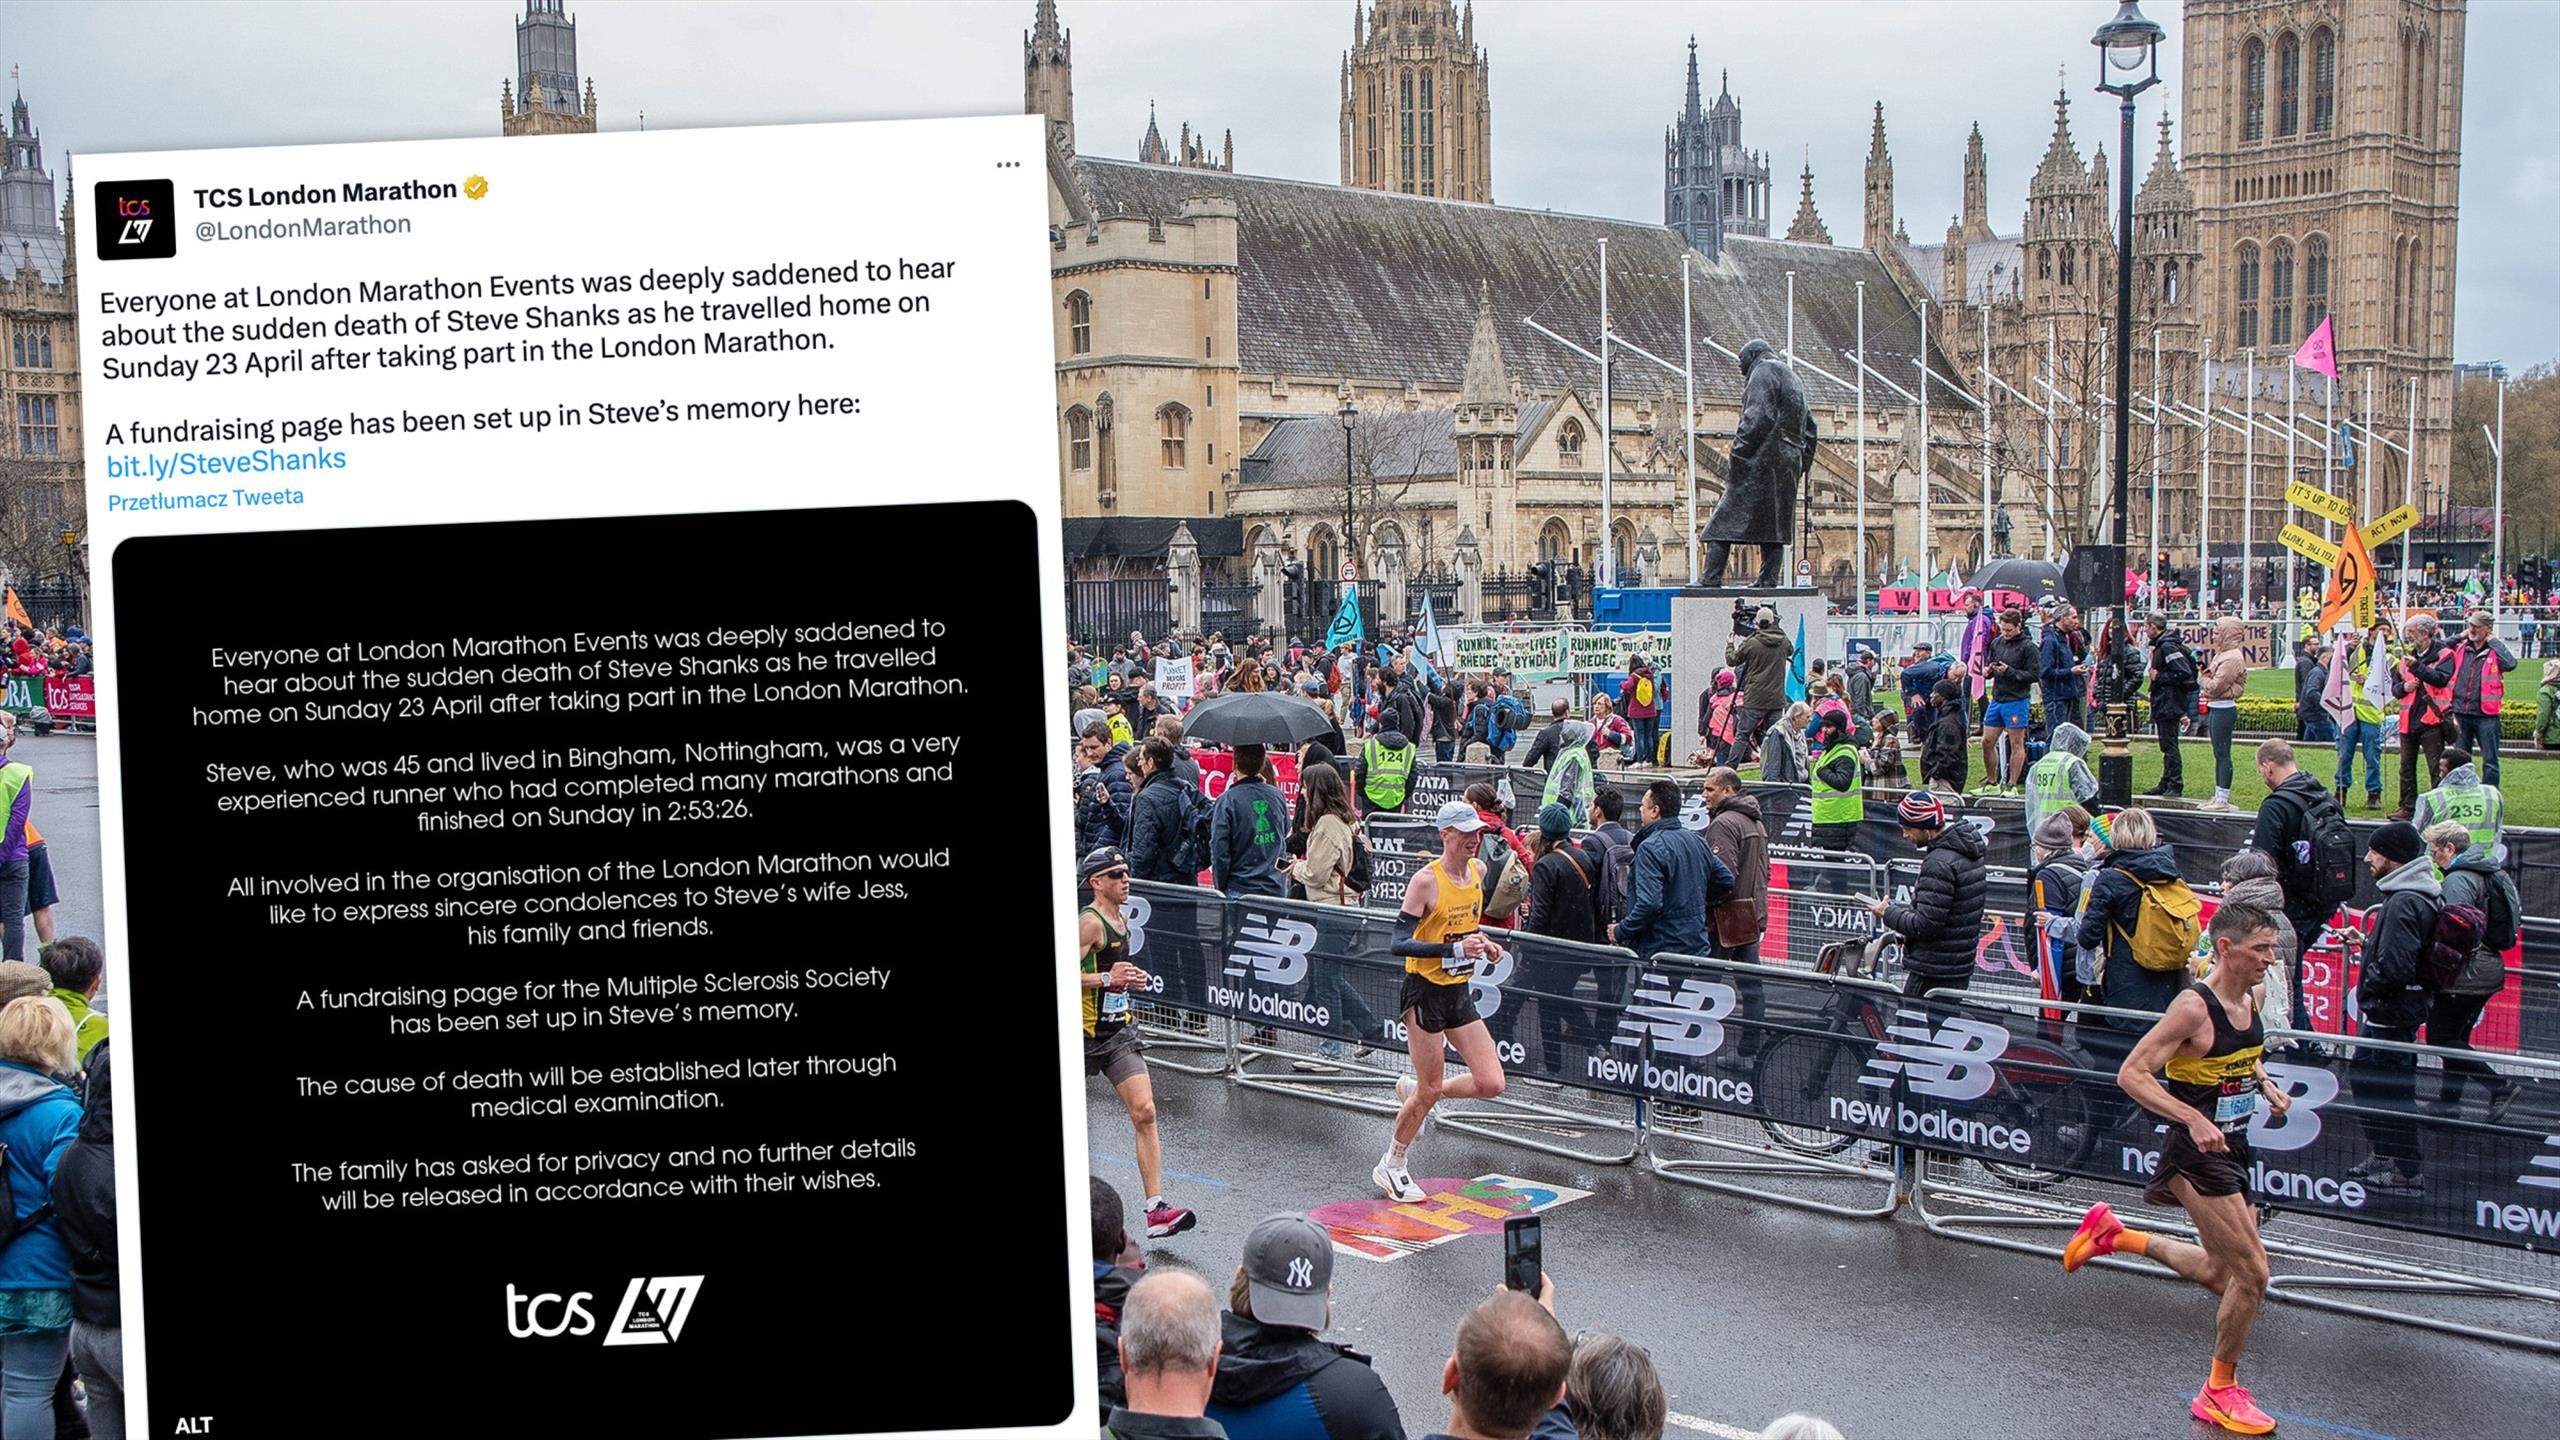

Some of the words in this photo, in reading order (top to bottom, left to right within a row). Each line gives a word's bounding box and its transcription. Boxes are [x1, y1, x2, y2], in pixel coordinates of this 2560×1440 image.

[2312, 494, 2326, 506] UP
[2329, 500, 2339, 512] TO
[2370, 523, 2387, 539] ACT
[2390, 511, 2409, 528] NOW
[2306, 542, 2321, 556] THE
[1457, 636, 1498, 652] RUNNING
[1530, 636, 1558, 651] LIVES
[1570, 637, 1617, 651] RUNNING
[47, 682, 68, 709] tcs
[1162, 681, 1187, 690] PROFIT
[1379, 751, 1403, 763] 124
[2450, 804, 2484, 818] 235
[1207, 984, 1245, 1010] new
[1248, 987, 1330, 1027] balance
[1383, 1017, 1409, 1043] ne
[1587, 1055, 1639, 1085] new
[1643, 1059, 1754, 1105] balance
[1830, 1096, 1892, 1128] new
[1897, 1101, 2032, 1154] balance
[2122, 1146, 2161, 1176] ne
[2247, 1160, 2367, 1208] lance
[2476, 1199, 2560, 1239] new
[1286, 1256, 1314, 1288] NY
